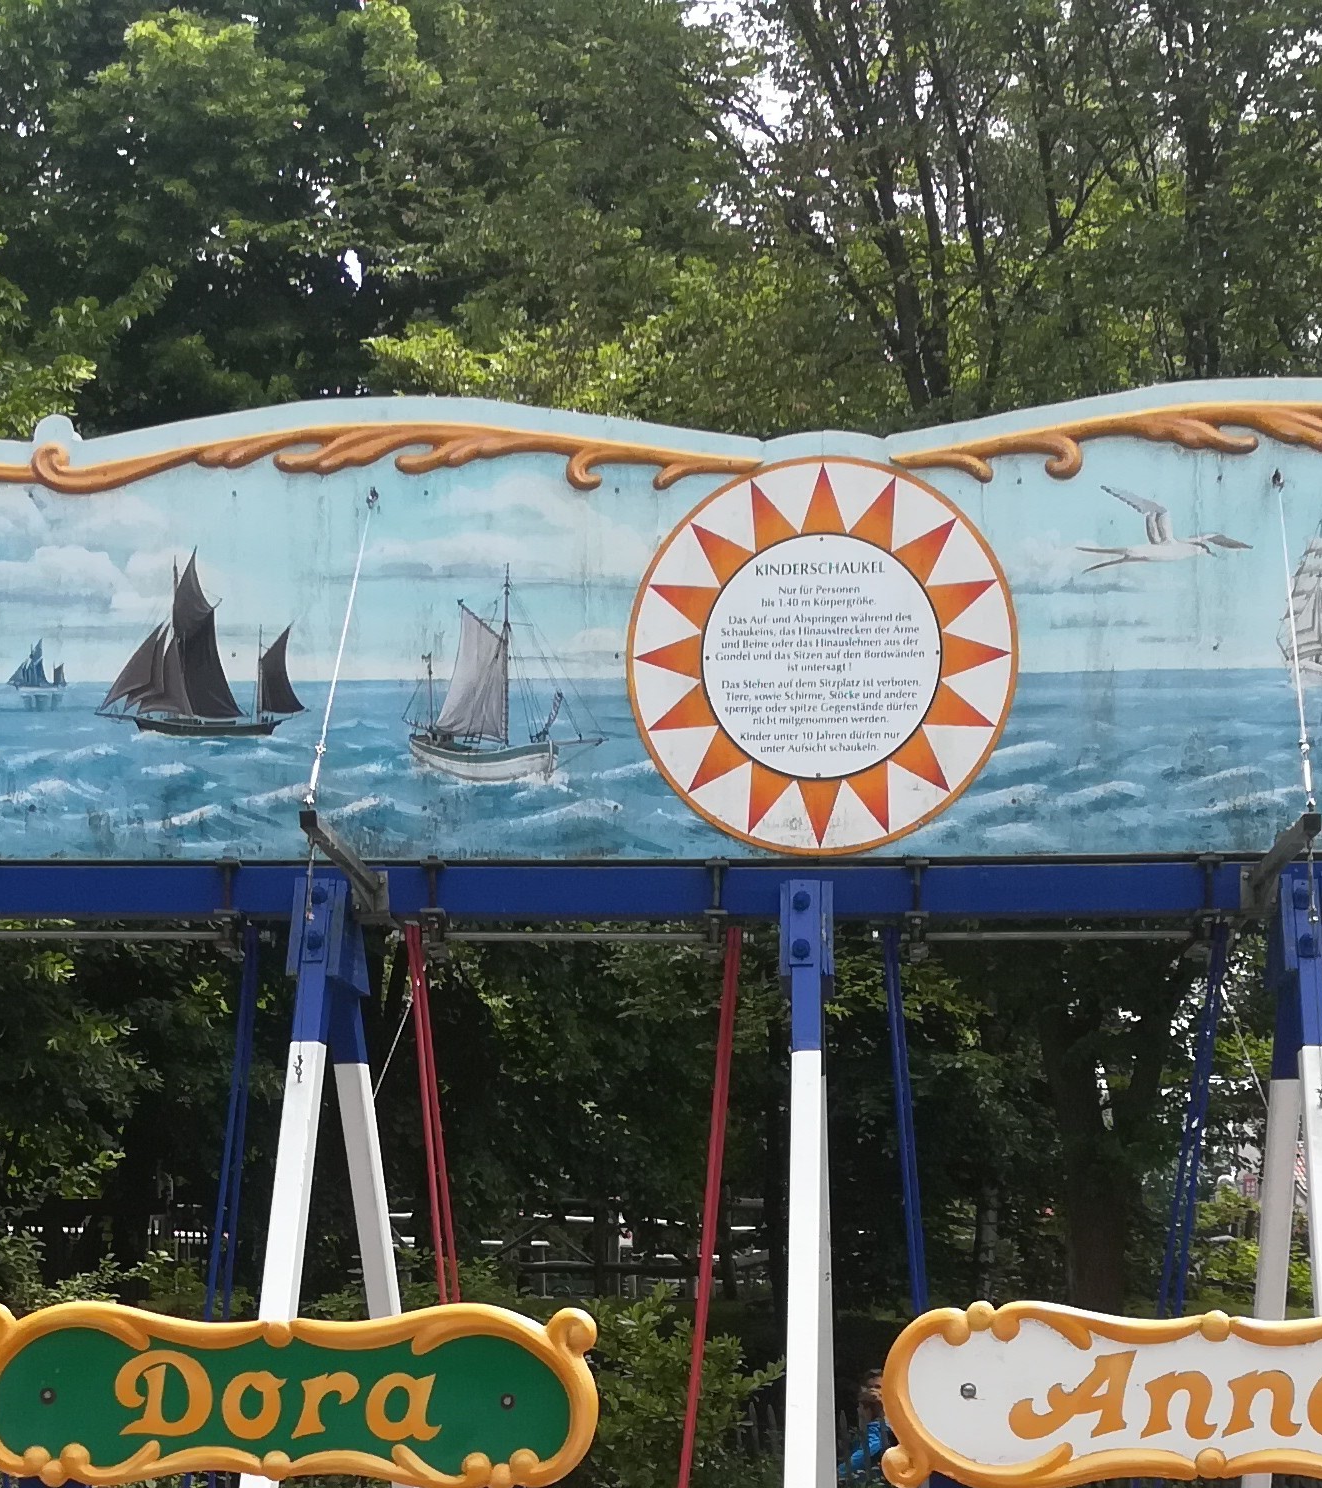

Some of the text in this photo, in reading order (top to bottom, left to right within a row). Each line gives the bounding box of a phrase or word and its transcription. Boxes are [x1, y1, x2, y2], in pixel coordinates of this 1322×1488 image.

[755, 561, 885, 576] KINDERSCHAUKEL
[779, 585, 860, 594] Nur für Personen
[729, 616, 747, 624] Das
[773, 615, 790, 623] und
[794, 615, 847, 625] Abspringen
[851, 613, 892, 622] während
[895, 613, 911, 621] des
[779, 627, 795, 635] das
[799, 625, 871, 635] Hinausstrecken
[875, 626, 889, 634] der
[721, 637, 918, 648] und Beine oder das Hinauslehnen aus der
[715, 650, 924, 661] Gondel und das Sitzen auf den Bordwänden
[801, 664, 846, 674] untersagt
[721, 677, 921, 689] Das Stehen auf dem Sitzplatz ist verboten.
[785, 692, 825, 700] Schirme,
[829, 691, 859, 700] Stöcke
[863, 691, 881, 699] und
[725, 702, 918, 714] sperrige oder spitze Gegenstände dürfen
[753, 715, 888, 726] nicht mitgenommen werden.
[740, 732, 771, 740] Kinder
[774, 732, 798, 740] unter
[803, 732, 813, 740] 10
[816, 731, 847, 740] Jahren
[850, 730, 880, 739] dürfen
[761, 745, 785, 753] unter
[788, 744, 826, 753] Aufsicht
[117, 1349, 441, 1443] Dora
